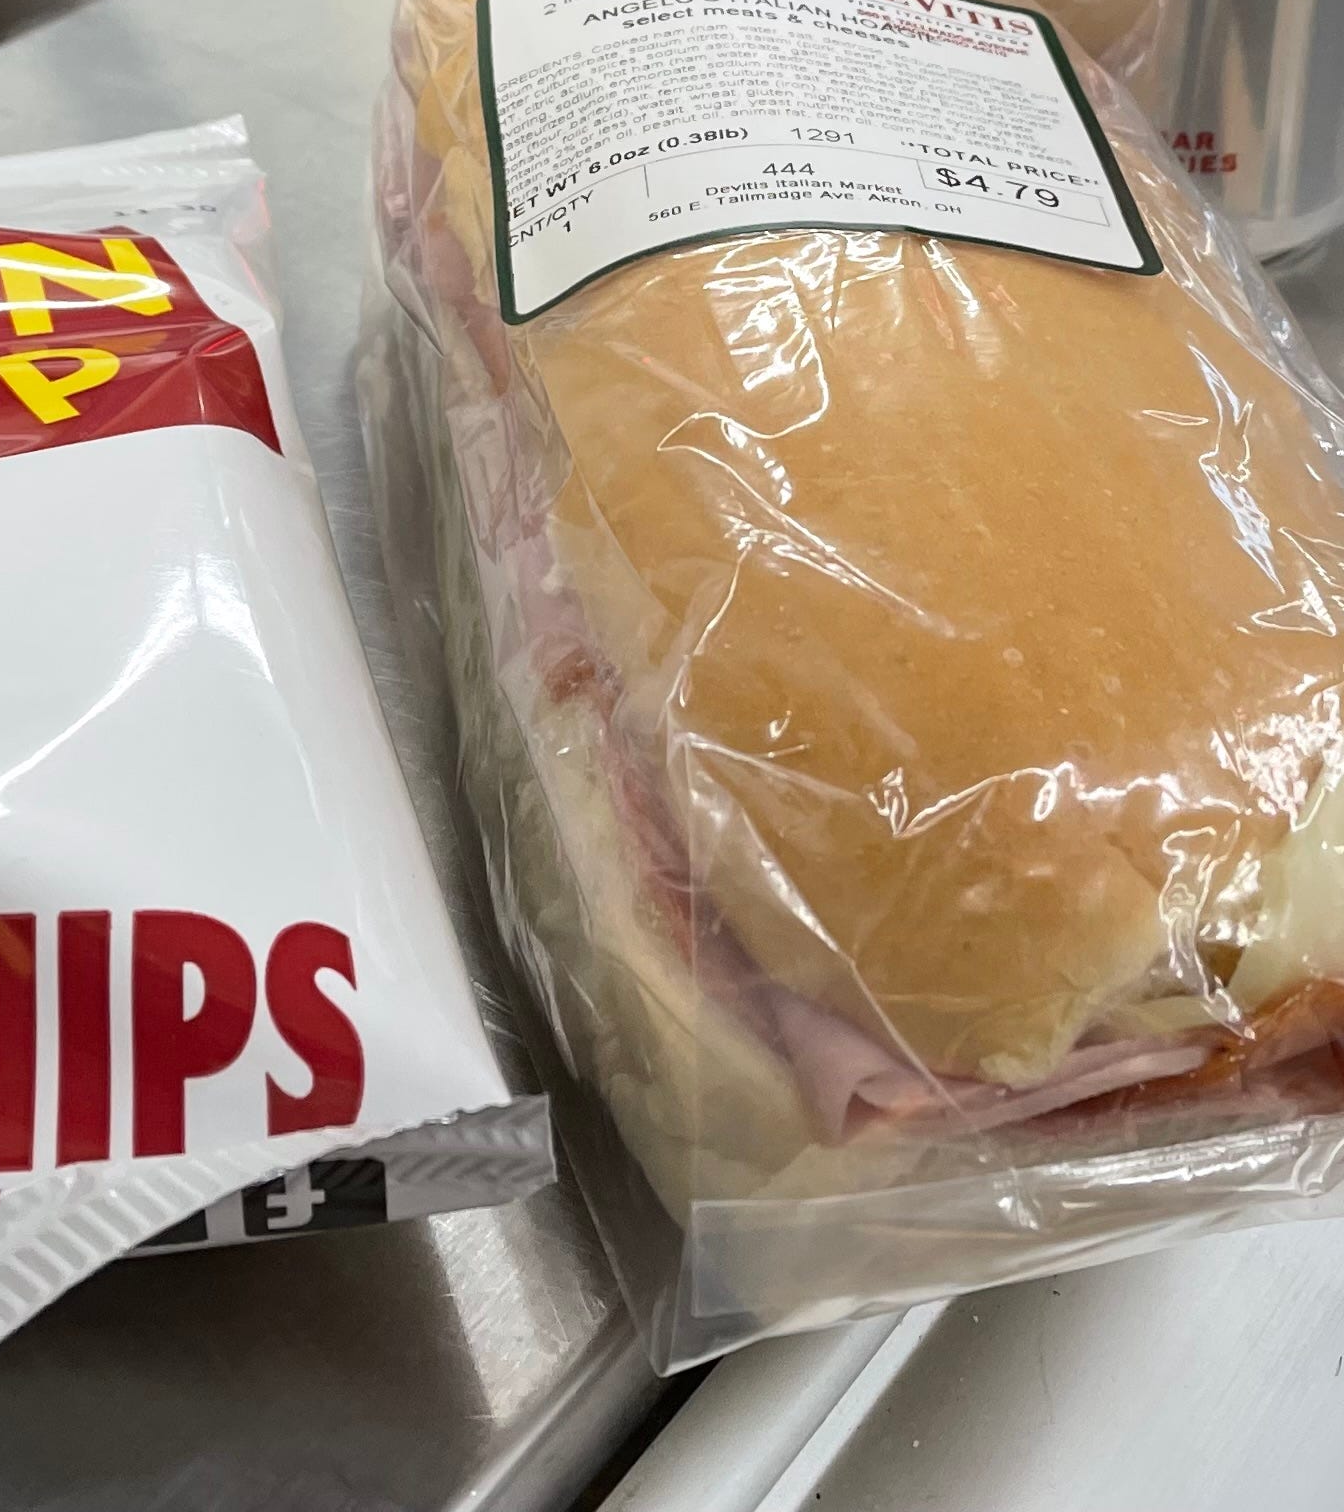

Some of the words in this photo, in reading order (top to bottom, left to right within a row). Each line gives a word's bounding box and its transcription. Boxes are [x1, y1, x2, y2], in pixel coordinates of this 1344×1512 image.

[544, 3, 557, 16] 2
[622, 6, 694, 30] select
[703, 6, 778, 21] meats
[787, 13, 805, 25] &
[813, 20, 911, 49] cheeses
[497, 51, 582, 94] GREDIENTS
[592, 34, 649, 55] Cooked
[497, 83, 534, 105] odium
[537, 51, 619, 86] erythorbate
[629, 38, 683, 55] sodium
[498, 94, 530, 116] arter
[534, 73, 580, 99] culture
[646, 45, 699, 61] sodium
[555, 85, 604, 114] sodium
[706, 59, 761, 69] sodium
[505, 110, 574, 152] asteurized
[578, 90, 617, 115] whole
[623, 83, 653, 95] milk
[662, 71, 717, 87] cheese
[723, 69, 784, 78] cultures
[570, 103, 613, 130] barley
[718, 77, 770, 88] sulfate
[746, 88, 794, 98] gluten
[506, 157, 550, 185] ntains
[599, 120, 627, 136] less
[633, 112, 647, 124] of
[506, 172, 544, 198] ntain
[552, 138, 611, 171] soybean
[642, 113, 697, 134] peanut
[545, 170, 581, 198] WT
[588, 145, 650, 175] 6.0oz
[657, 127, 749, 153] (0.38lb)
[789, 127, 856, 145] 1291
[705, 179, 769, 197] Devitis
[775, 178, 833, 189] Italian
[839, 180, 903, 196] Market
[762, 162, 815, 176] 444
[935, 166, 1060, 209] $4.79
[509, 189, 594, 248] CNT/QTY
[562, 220, 572, 234] 1
[647, 205, 682, 223] 560
[717, 189, 813, 207] Tallmadge
[933, 203, 963, 216] OH
